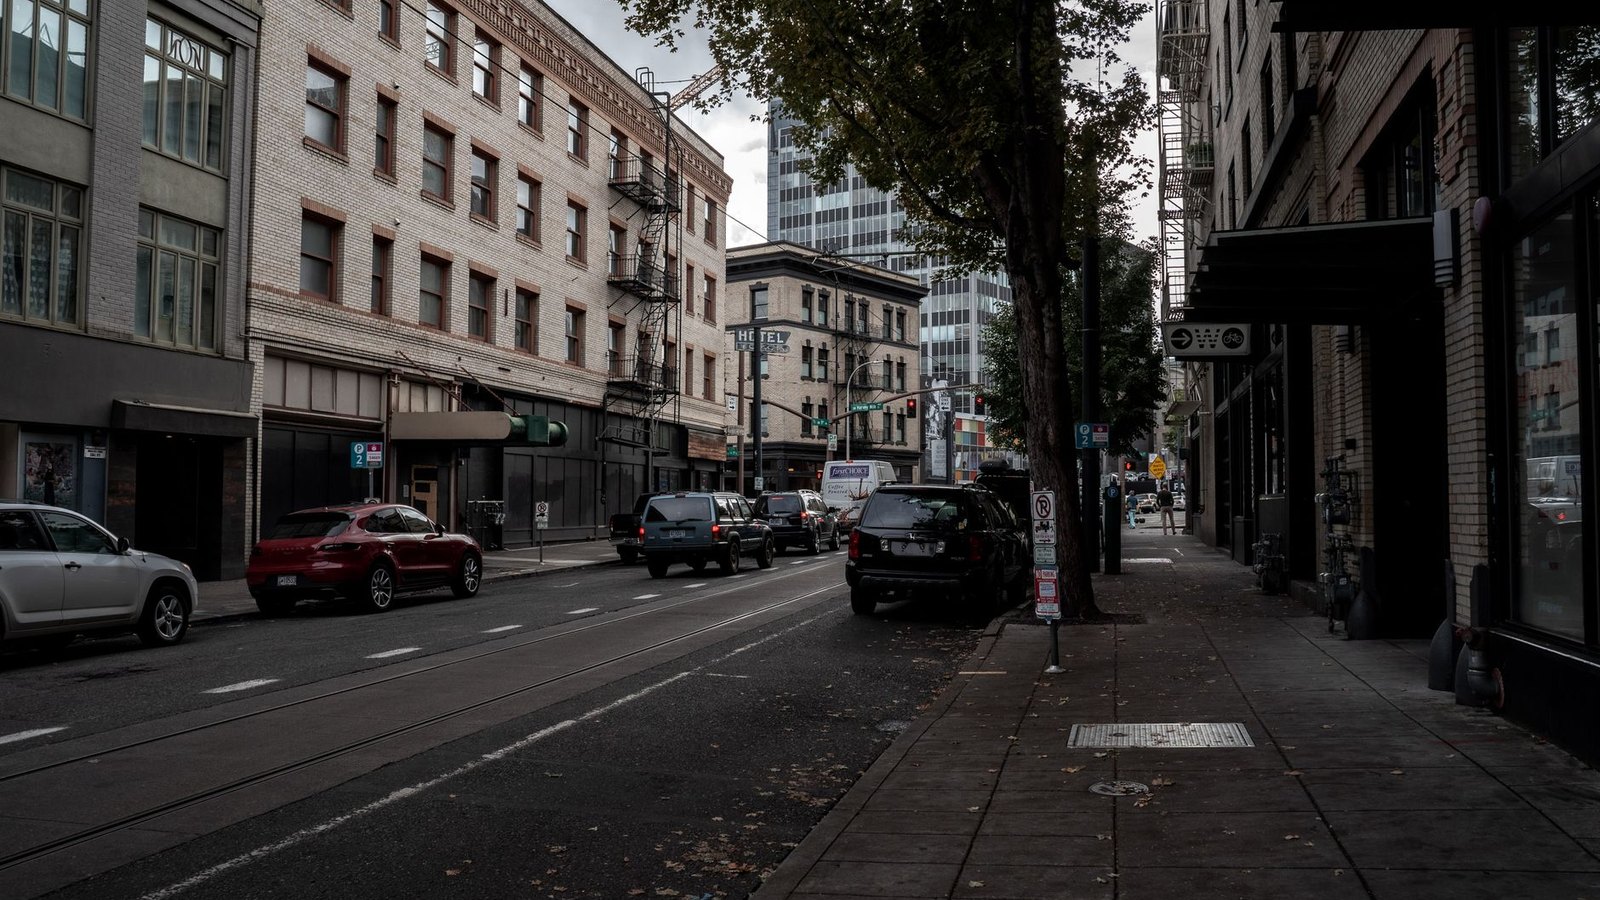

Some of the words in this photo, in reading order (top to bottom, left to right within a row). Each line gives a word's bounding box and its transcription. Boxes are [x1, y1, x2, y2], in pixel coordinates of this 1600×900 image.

[738, 330, 784, 343] HOTEL
[1082, 435, 1088, 445] 2
[356, 454, 363, 464] 2
